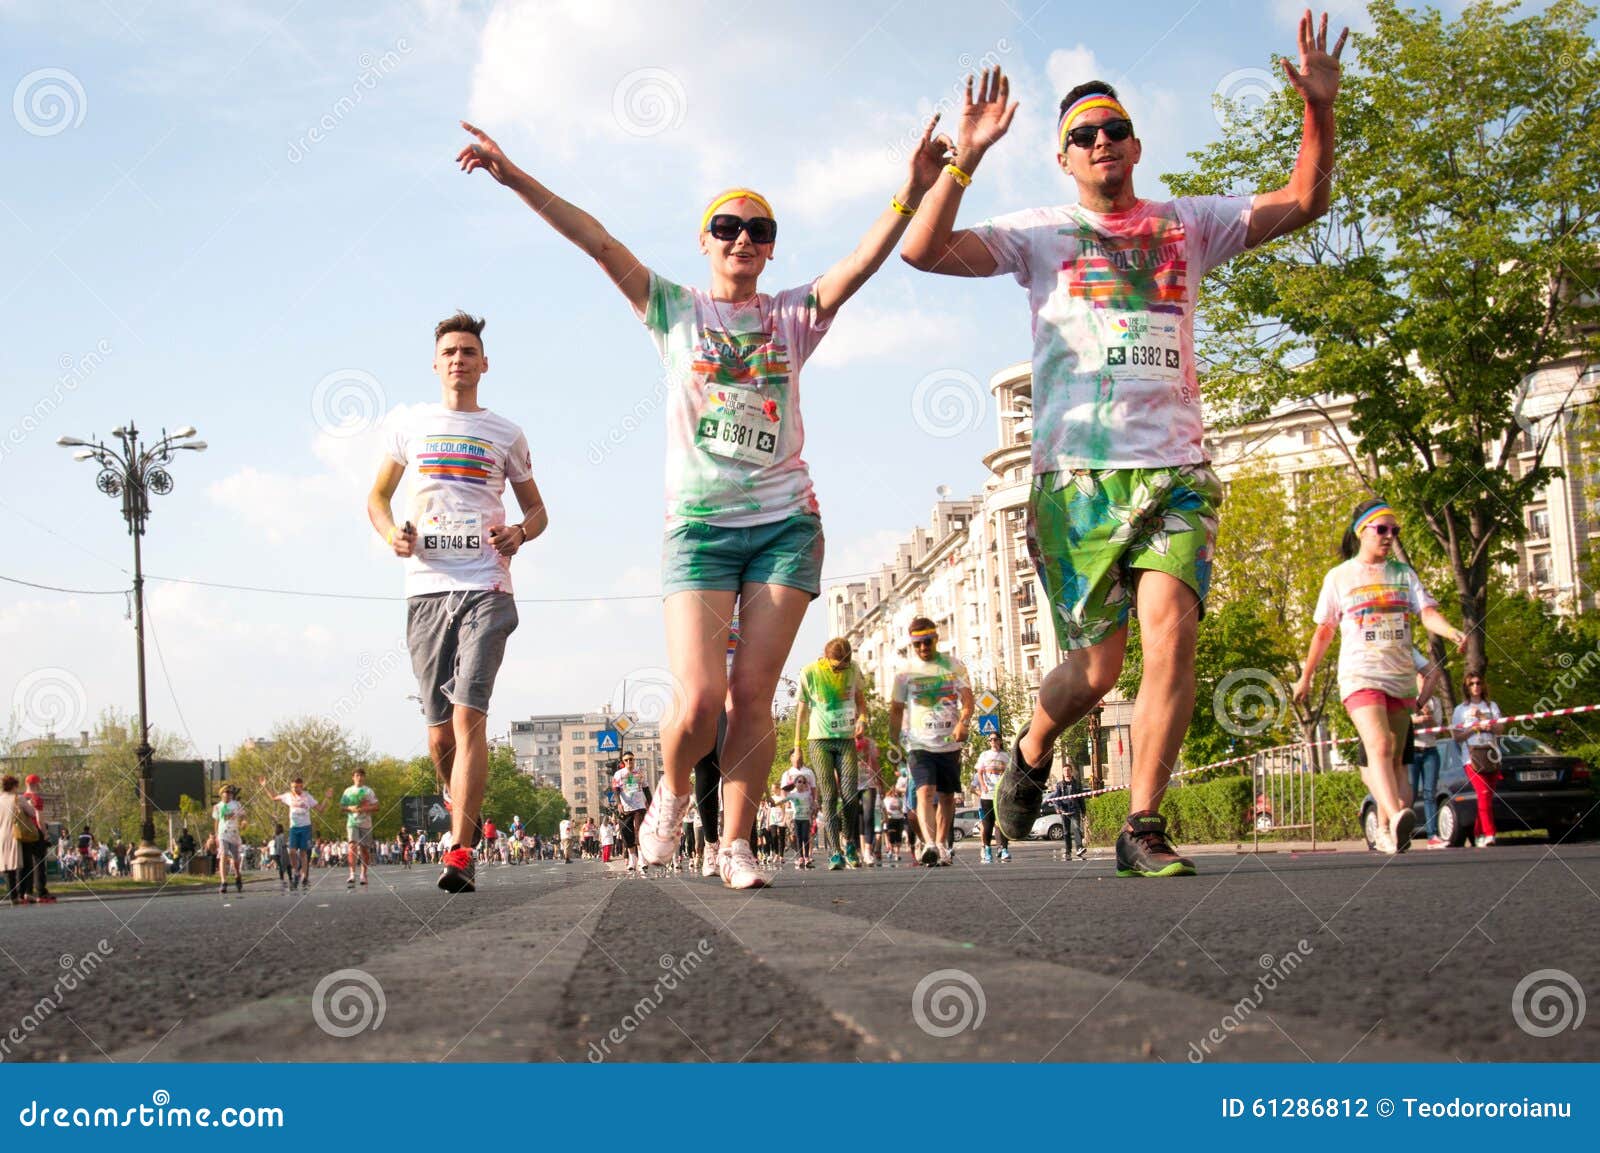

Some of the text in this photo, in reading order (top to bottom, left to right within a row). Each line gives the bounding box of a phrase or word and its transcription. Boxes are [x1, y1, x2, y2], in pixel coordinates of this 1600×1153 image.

[1132, 346, 1162, 367] 6382
[722, 422, 754, 448] 6381
[425, 442, 486, 457] THE COLOR RUN
[440, 535, 464, 550] 5748
